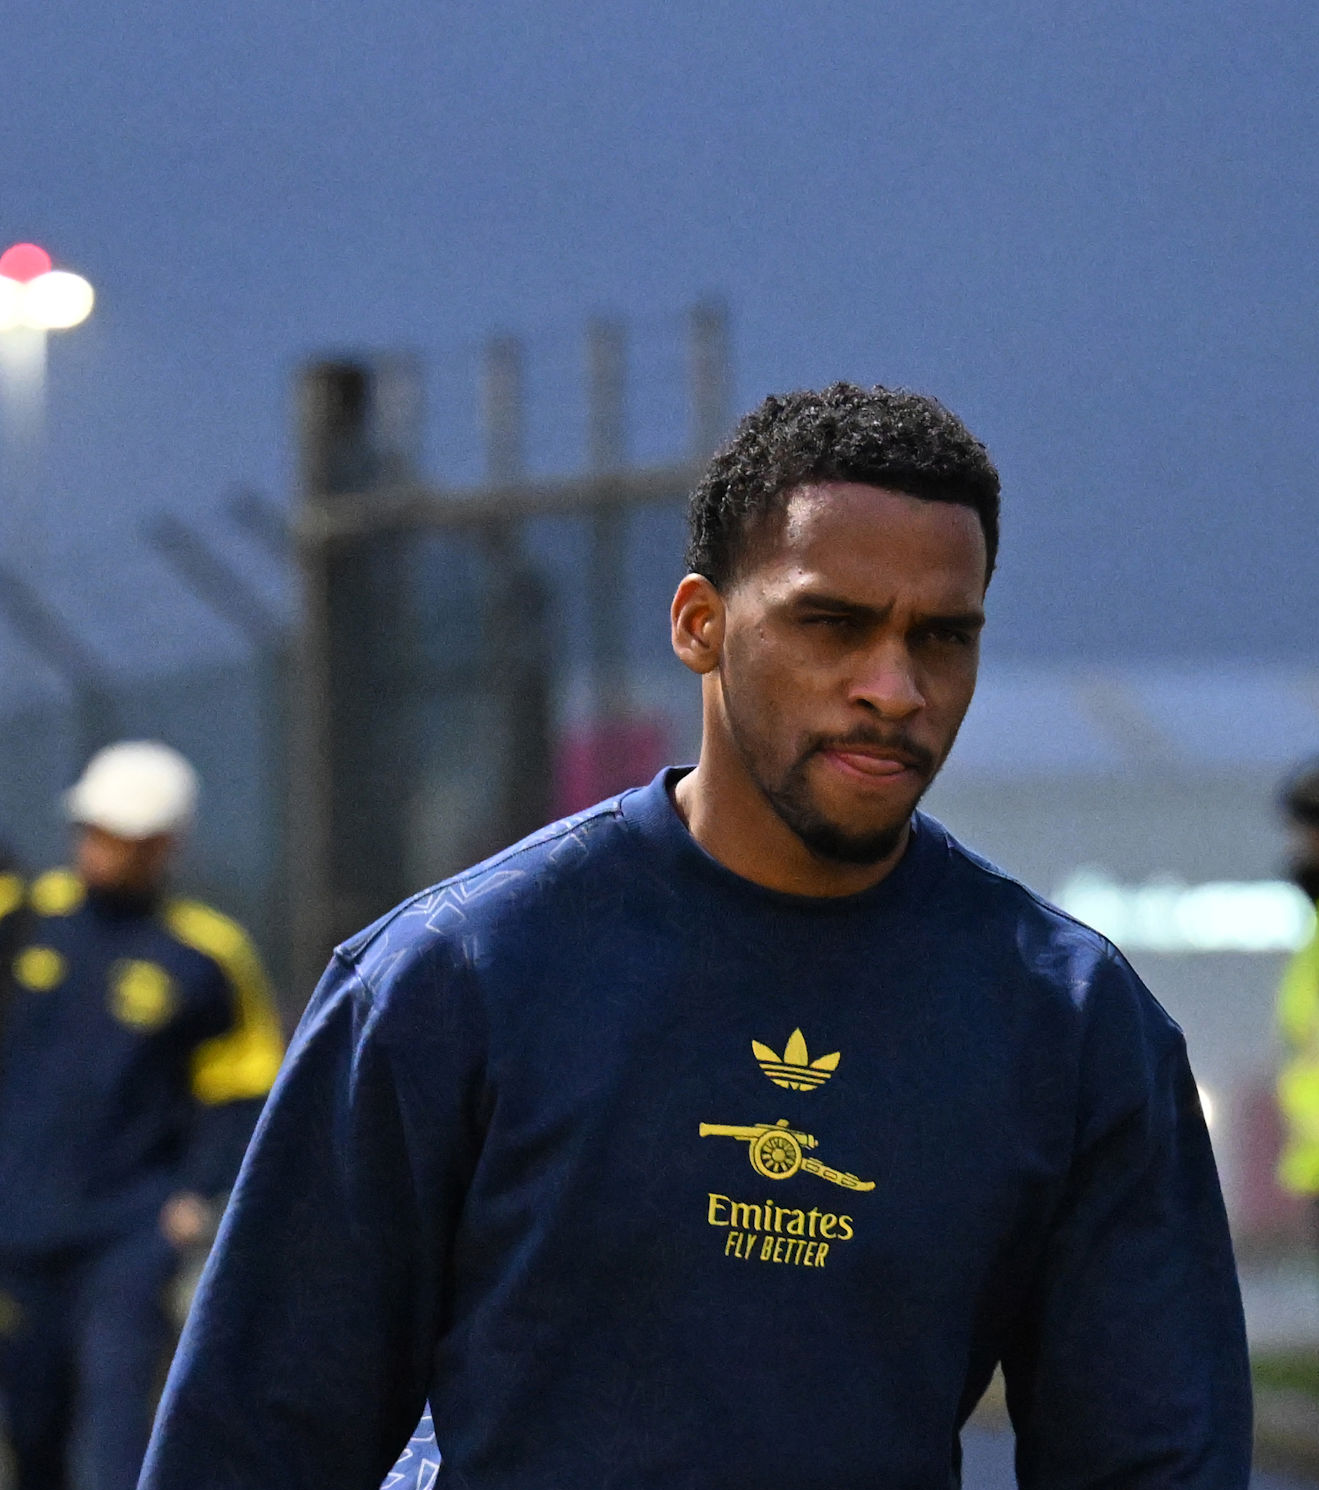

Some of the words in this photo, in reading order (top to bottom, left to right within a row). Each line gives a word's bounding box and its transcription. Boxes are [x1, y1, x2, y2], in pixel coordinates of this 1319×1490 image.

[707, 1192, 854, 1240] Emirates
[724, 1230, 756, 1261] FLY
[759, 1234, 830, 1268] BETTER
